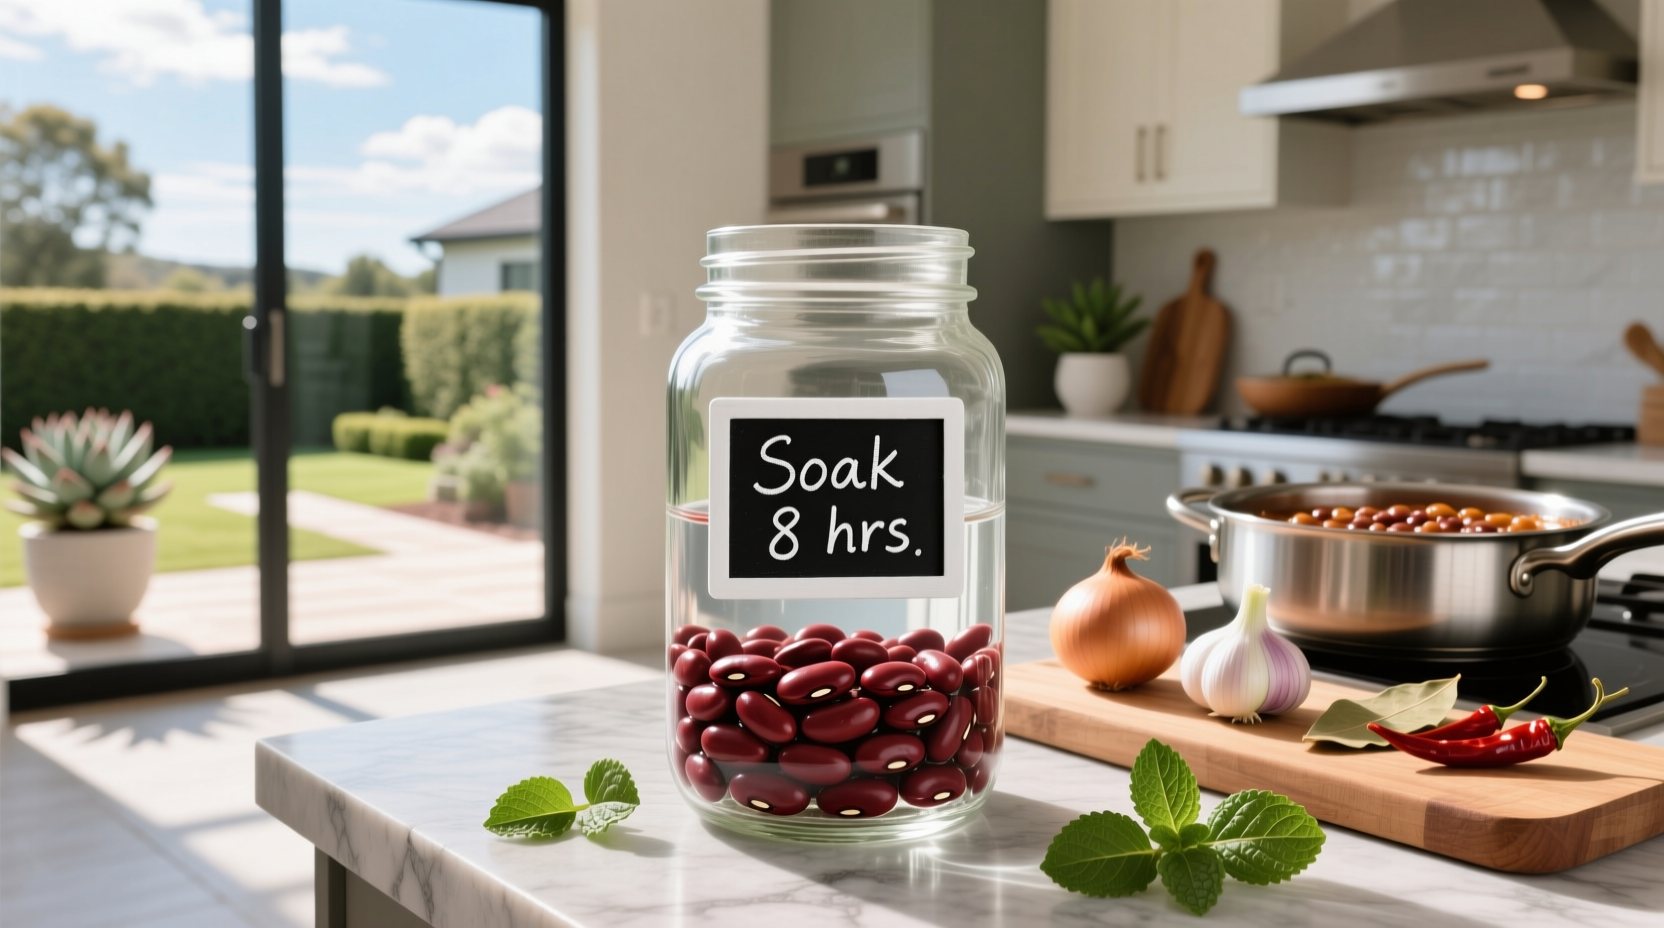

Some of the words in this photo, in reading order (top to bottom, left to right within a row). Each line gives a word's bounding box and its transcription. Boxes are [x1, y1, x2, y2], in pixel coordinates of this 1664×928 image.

[753, 434, 904, 495] Soak
[769, 506, 800, 560] 8
[827, 505, 922, 556] hrs.
